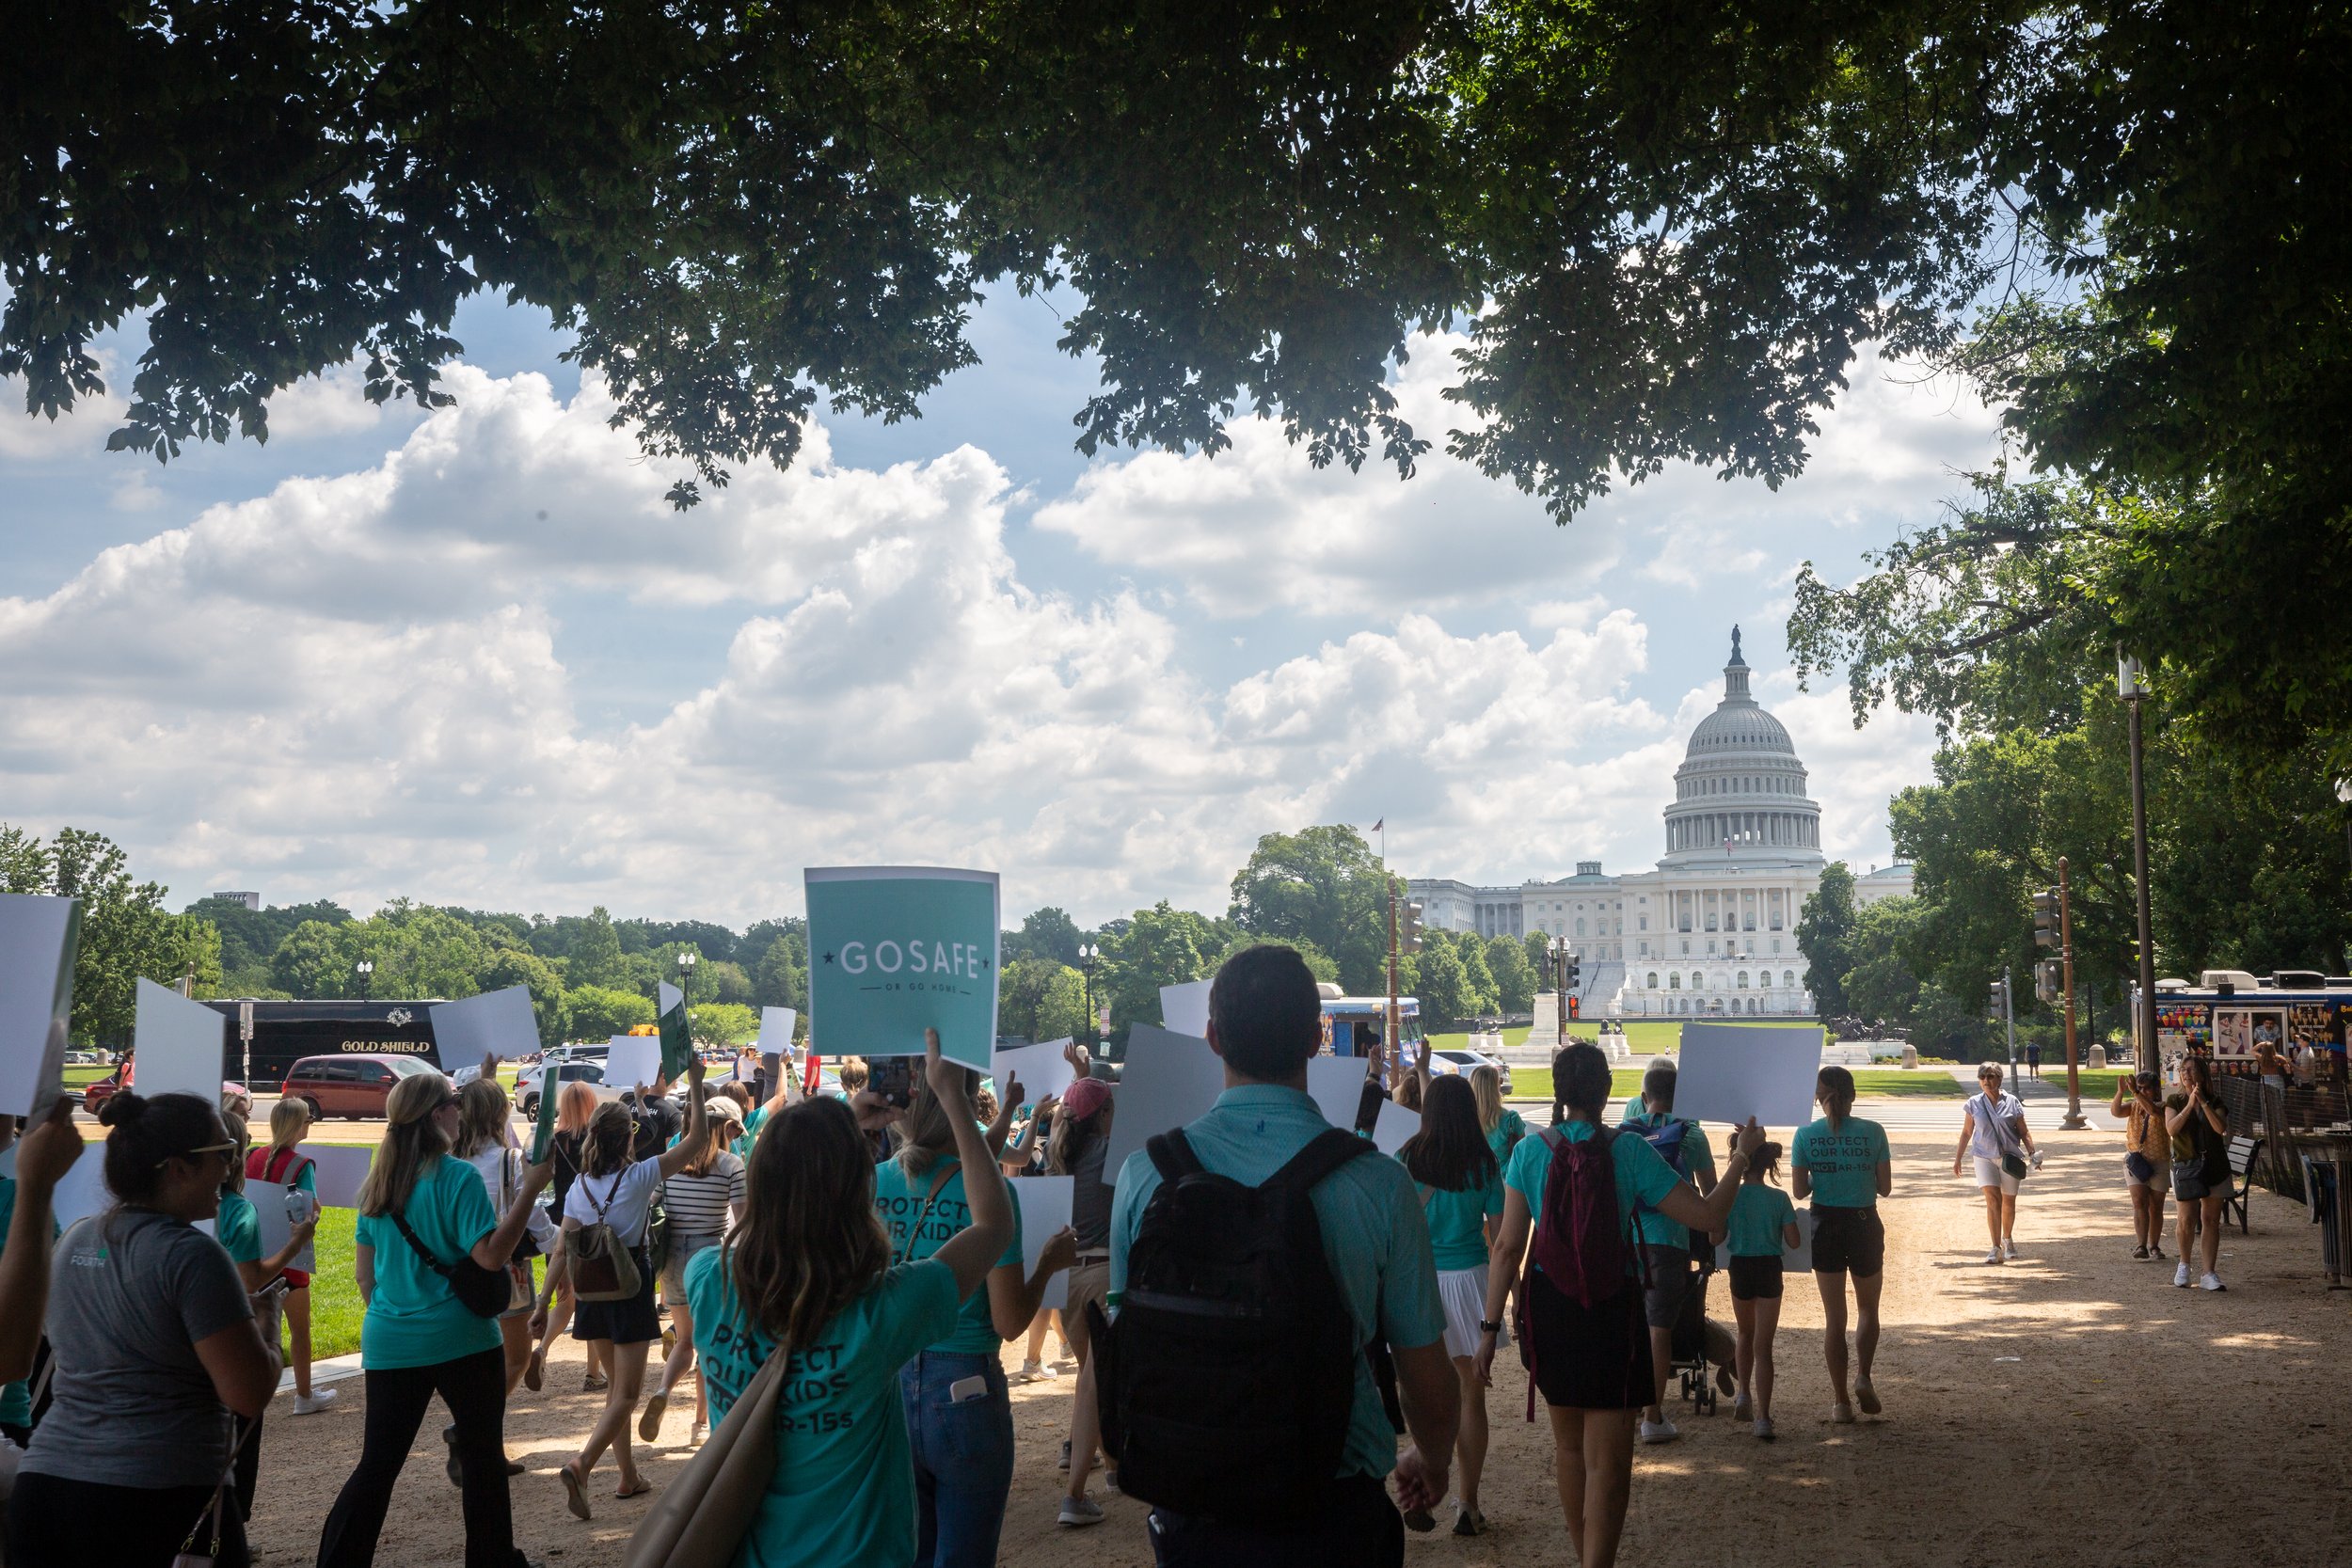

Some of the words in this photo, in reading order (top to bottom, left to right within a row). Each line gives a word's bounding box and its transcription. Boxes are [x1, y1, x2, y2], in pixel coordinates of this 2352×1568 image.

[840, 940, 977, 979] GOSAFE
[885, 983, 901, 991] OR
[909, 982, 924, 990] GO
[931, 983, 956, 993] HOME
[342, 1040, 378, 1053] GOLD
[379, 1041, 430, 1053] SHIELD
[630, 1106, 659, 1116] ENGH
[1809, 1136, 1868, 1147] PROTECT
[1810, 1148, 1837, 1157] OUR
[1842, 1148, 1870, 1157] KIDS
[1812, 1163, 1836, 1173] NOT
[875, 1196, 969, 1220] ROTECT
[707, 1356, 755, 1387] OU
